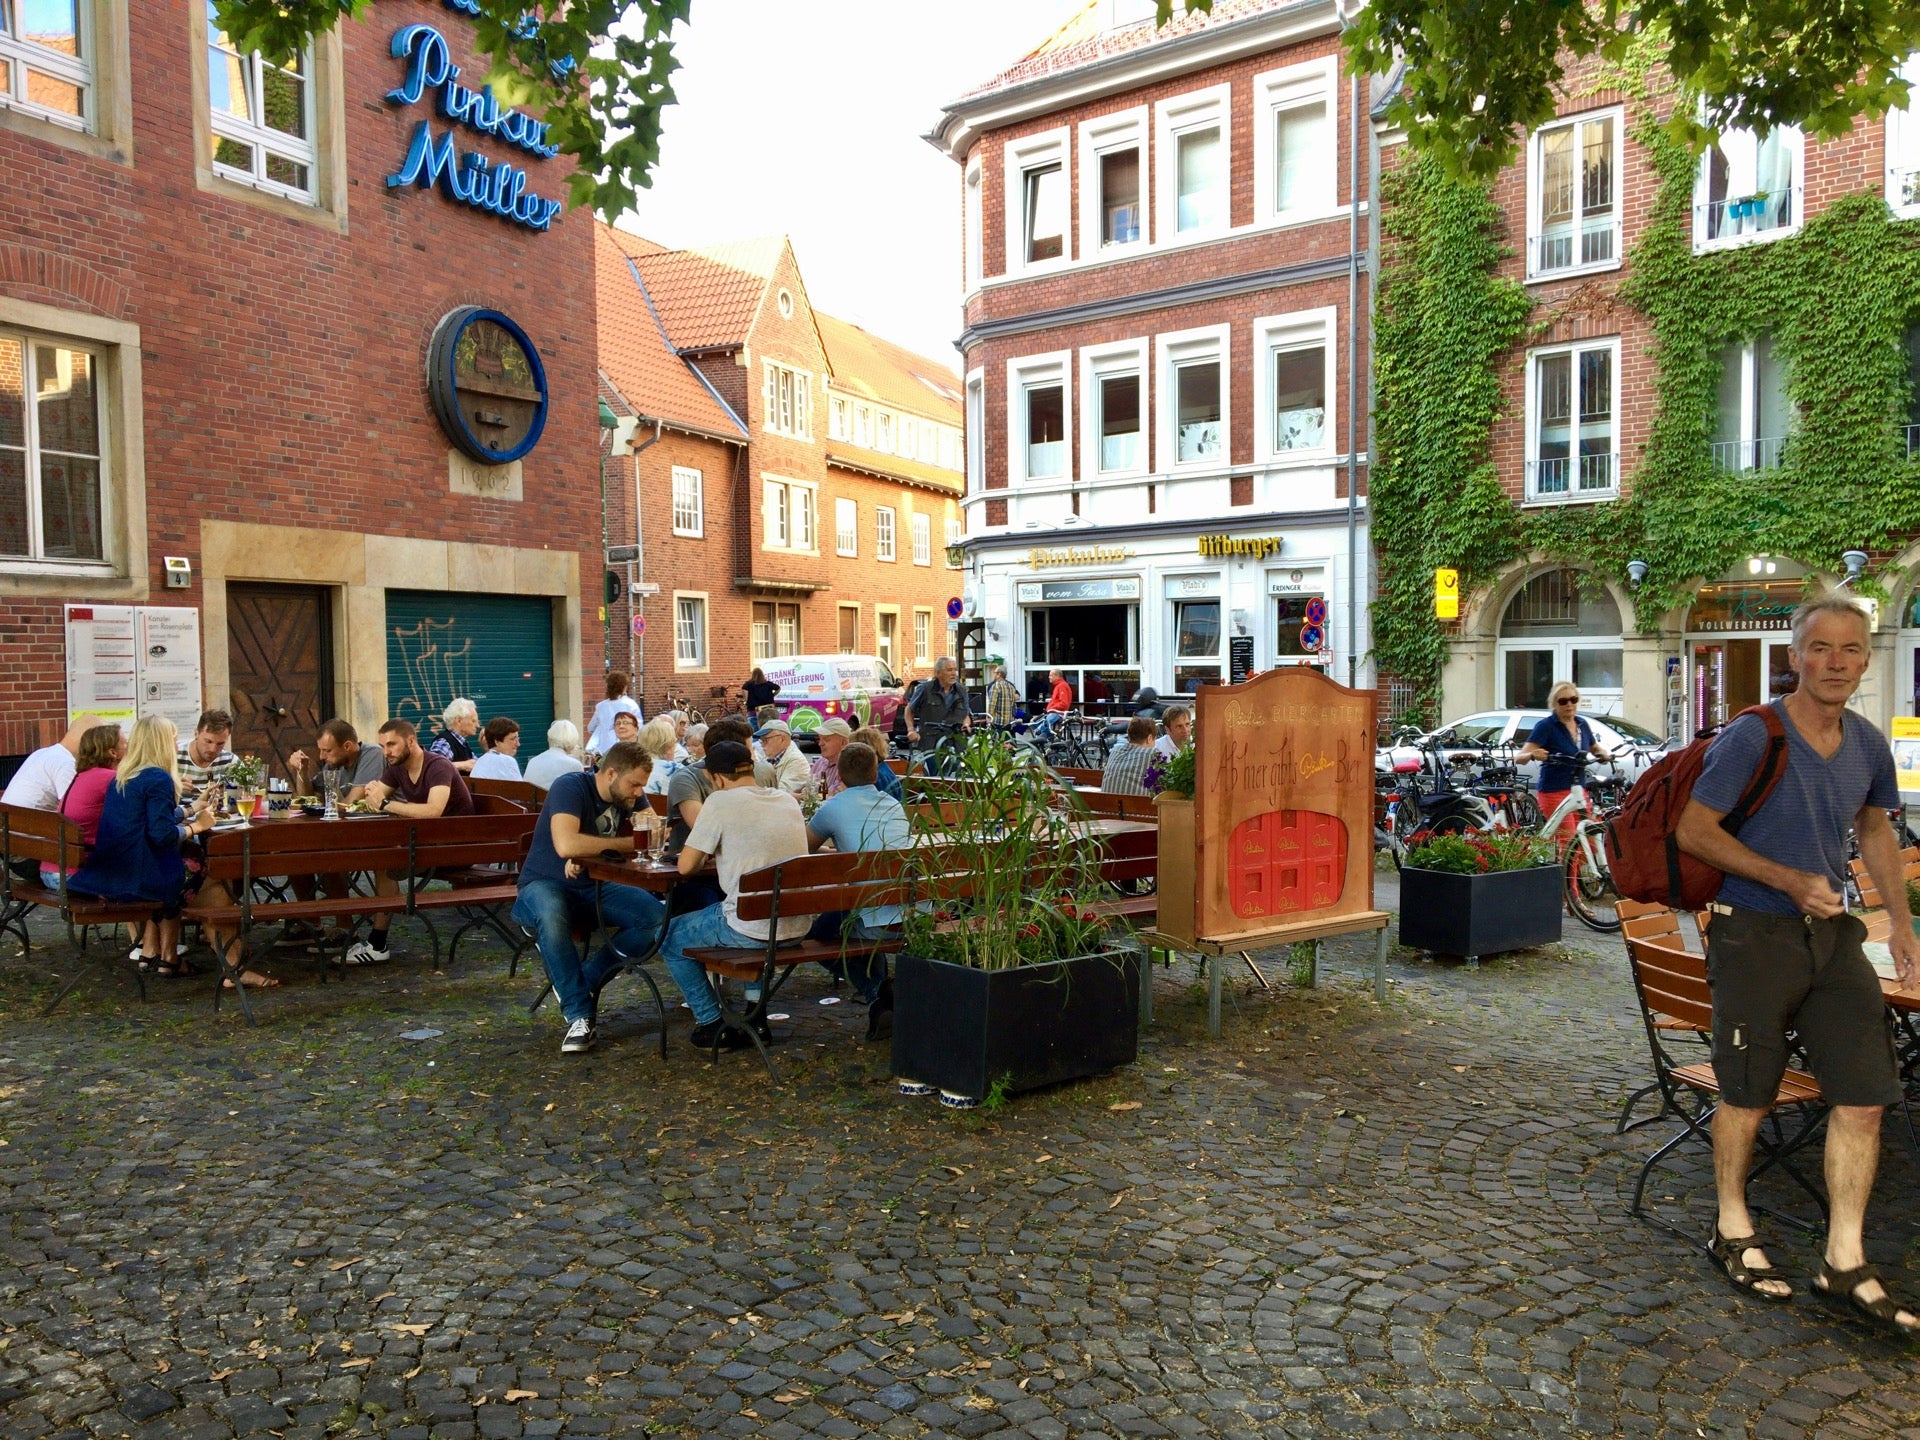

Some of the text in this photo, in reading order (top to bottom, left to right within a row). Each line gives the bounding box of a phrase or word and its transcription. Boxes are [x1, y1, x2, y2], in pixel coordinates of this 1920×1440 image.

[386, 119, 562, 232] Müller
[461, 467, 511, 491] 1962
[1029, 545, 1126, 571] Pinkulus
[1198, 535, 1283, 560] Bitburger
[175, 573, 182, 585] 4
[1699, 620, 1793, 630] VOLLWERTRESTA
[1272, 704, 1364, 726] BIERGARTEN
[1335, 738, 1362, 784] Bier
